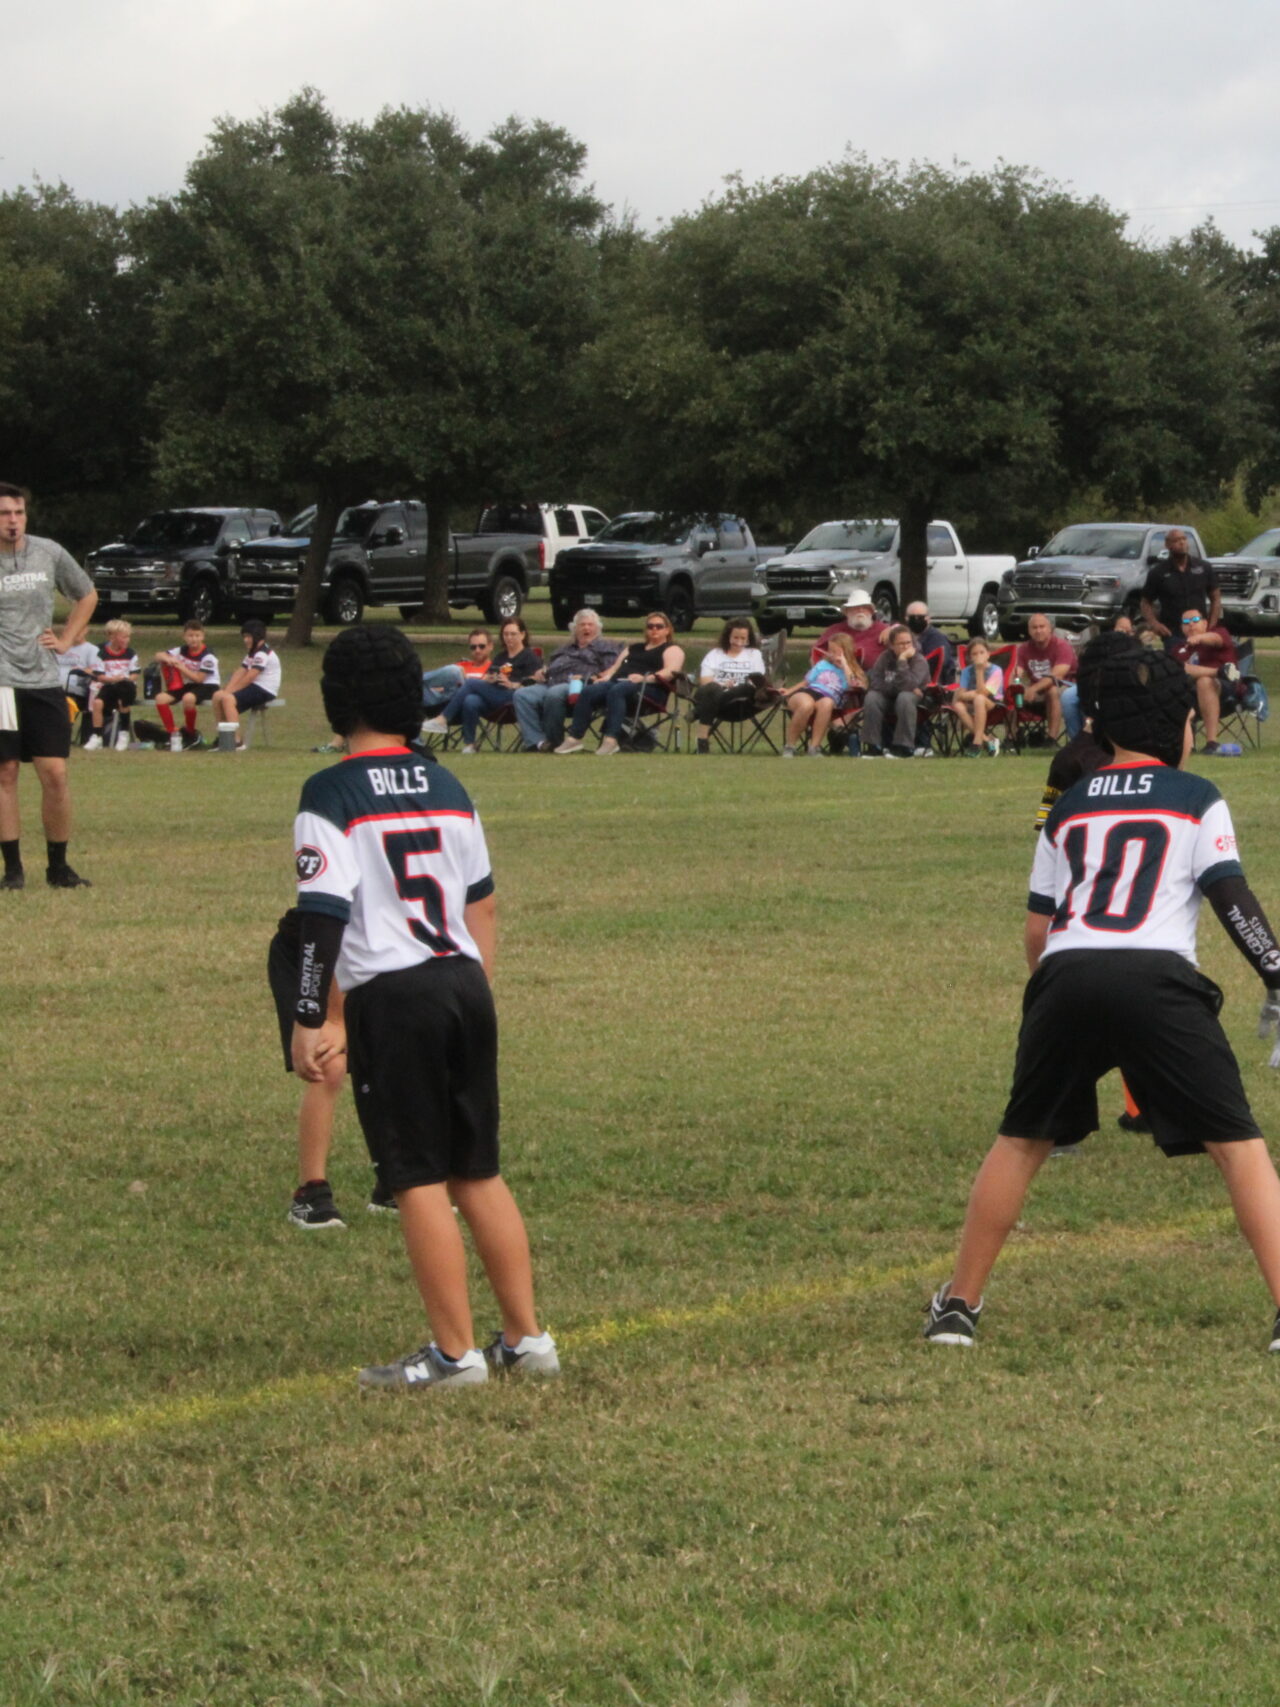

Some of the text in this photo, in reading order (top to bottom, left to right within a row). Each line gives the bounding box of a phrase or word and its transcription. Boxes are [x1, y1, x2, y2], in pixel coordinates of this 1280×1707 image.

[3, 572, 48, 584] CENTRAL
[367, 766, 429, 795] BILLS
[1087, 773, 1154, 796] BILLS
[382, 827, 461, 957] 5
[1049, 819, 1171, 934] 10
[1227, 904, 1265, 955] CENTRAL
[1249, 916, 1273, 949] SPORTS
[301, 941, 316, 996] CENTRAL
[310, 963, 324, 998] SPORTS
[404, 1362, 430, 1383] N
